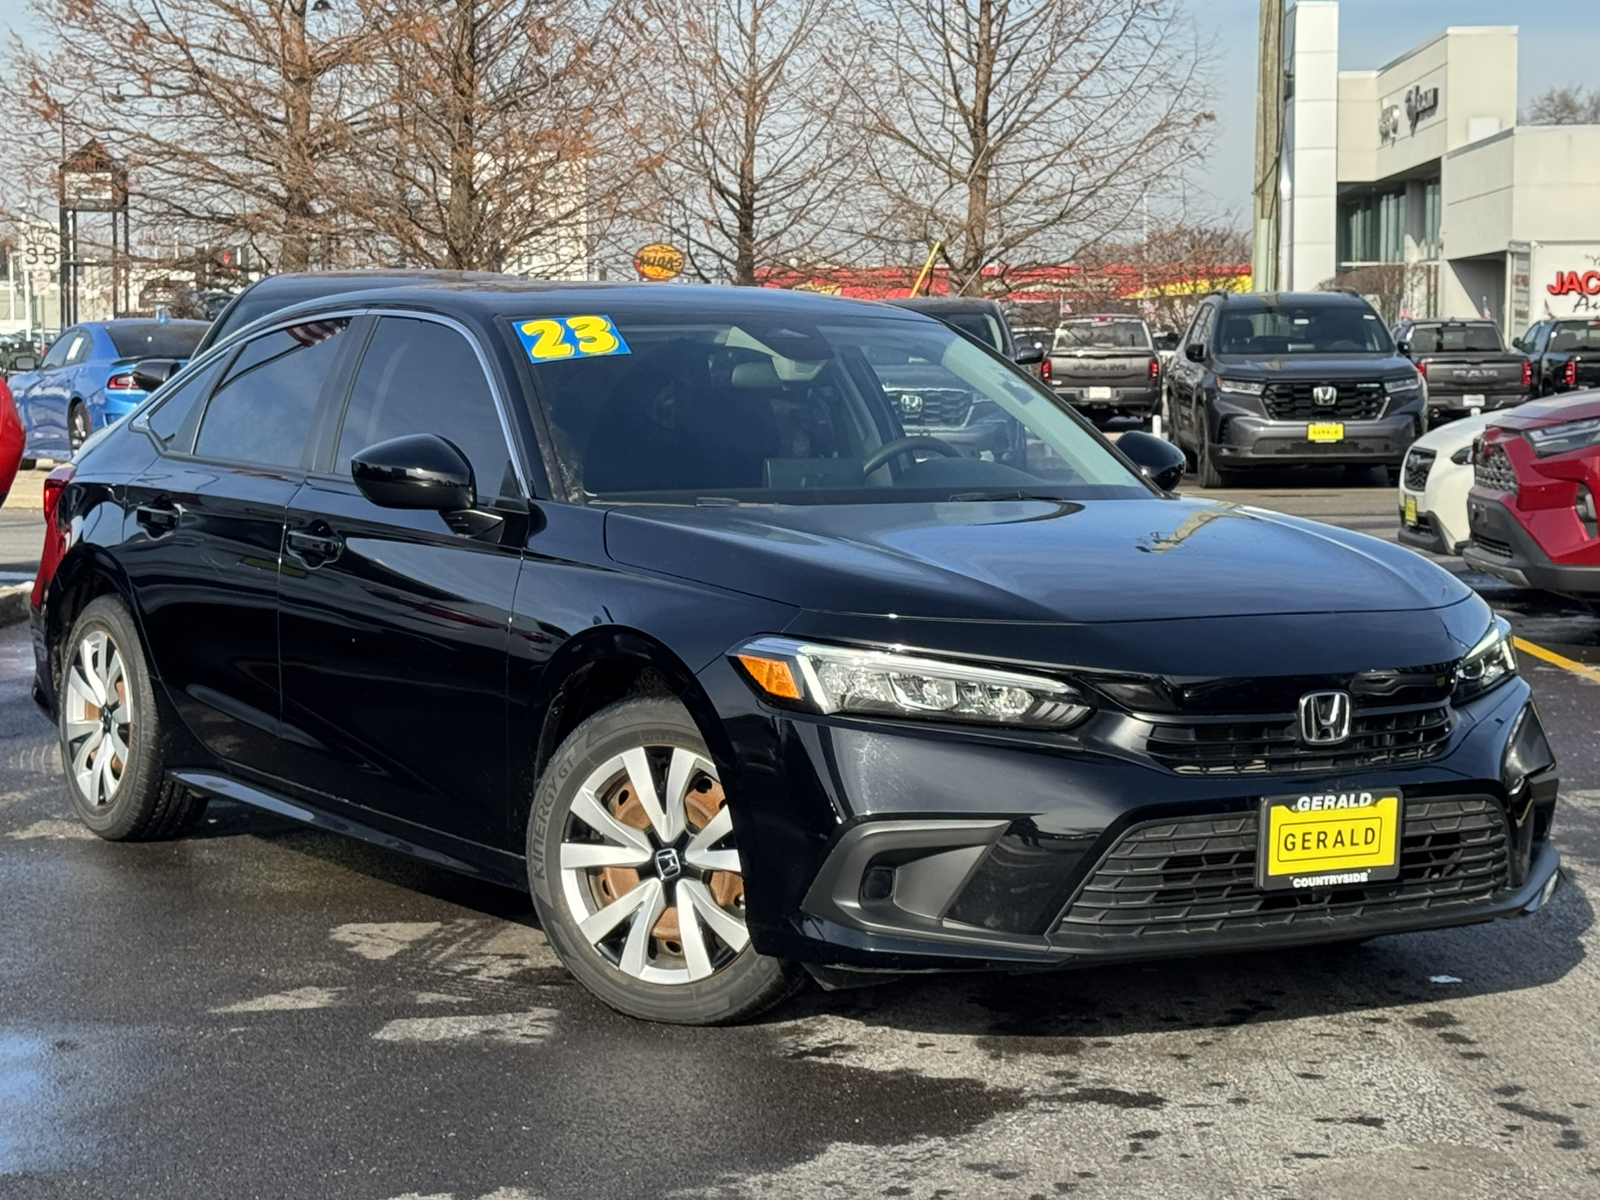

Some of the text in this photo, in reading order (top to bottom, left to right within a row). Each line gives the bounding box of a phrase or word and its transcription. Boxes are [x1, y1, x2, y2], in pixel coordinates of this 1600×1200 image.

[25, 247, 57, 265] 35
[520, 315, 620, 360] 23
[558, 755, 576, 779] GT
[1296, 792, 1372, 812] GERALD
[1284, 827, 1375, 852] GERALD
[1292, 872, 1369, 888] COUNTRYSIDE
